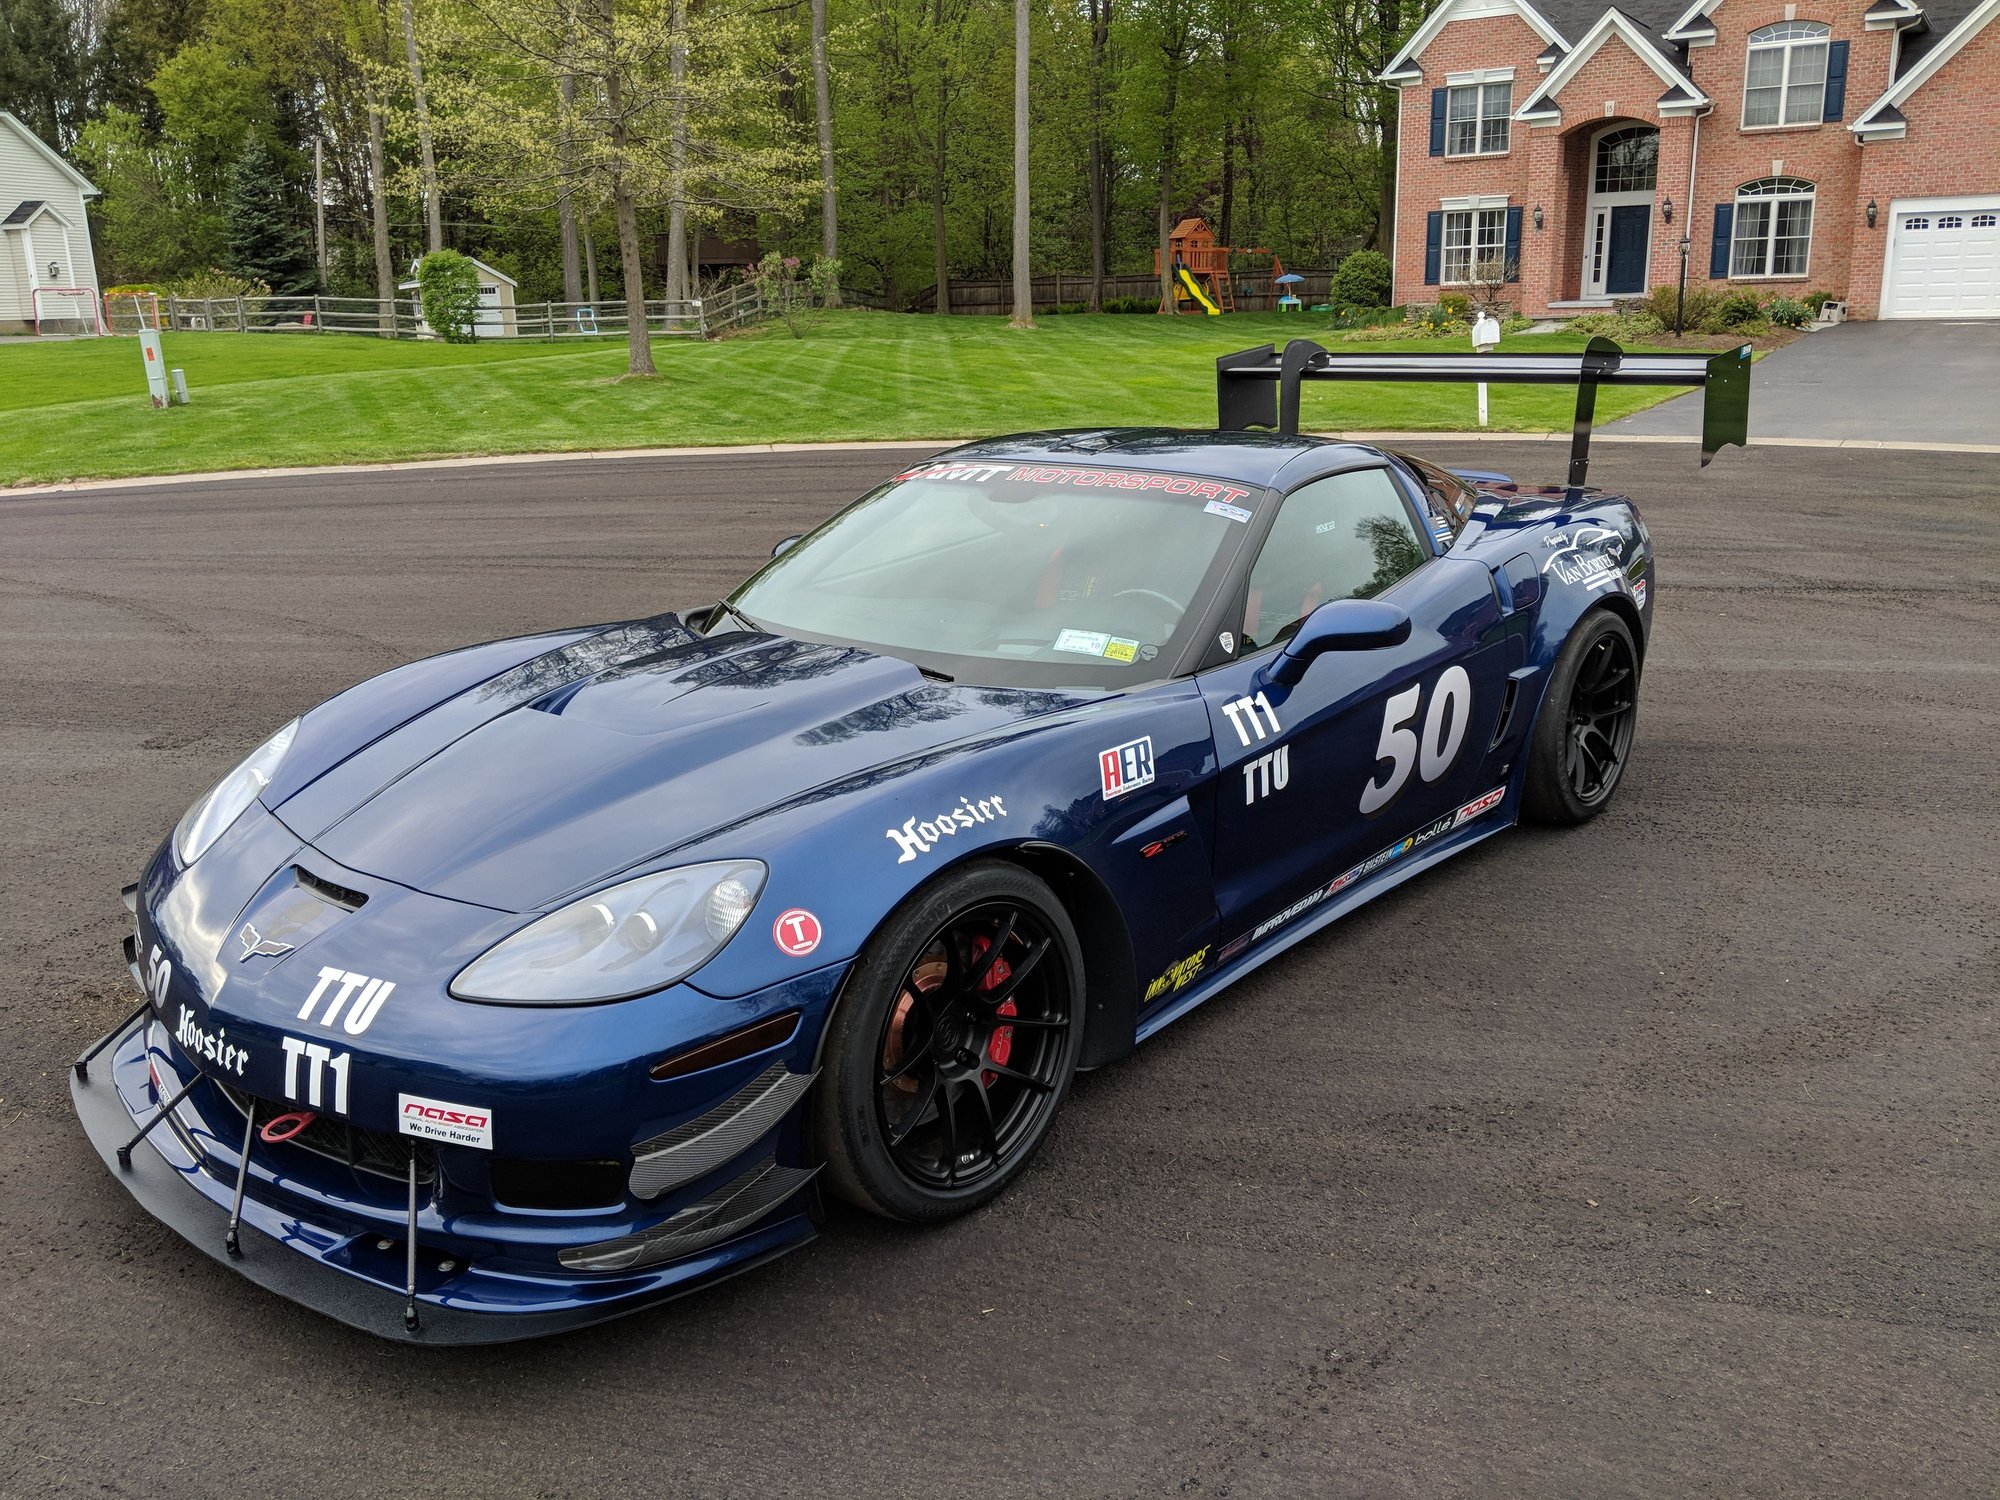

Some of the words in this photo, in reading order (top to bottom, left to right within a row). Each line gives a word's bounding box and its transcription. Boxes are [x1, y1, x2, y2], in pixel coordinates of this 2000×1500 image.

[1005, 466, 1250, 504] MOTORSPORT
[1221, 691, 1282, 747] TT1
[1359, 665, 1471, 814] 50
[1102, 739, 1152, 791] AER
[1243, 744, 1289, 806] TTU
[886, 796, 1008, 865] Hoosier
[146, 944, 172, 1009] 50
[297, 965, 397, 1036] TTU
[175, 1003, 250, 1077] Hoosier
[281, 1035, 351, 1116] TT1
[404, 1103, 488, 1129] nasa
[410, 1122, 422, 1133] We
[425, 1126, 447, 1138] Drive
[450, 1131, 481, 1144] Harder
